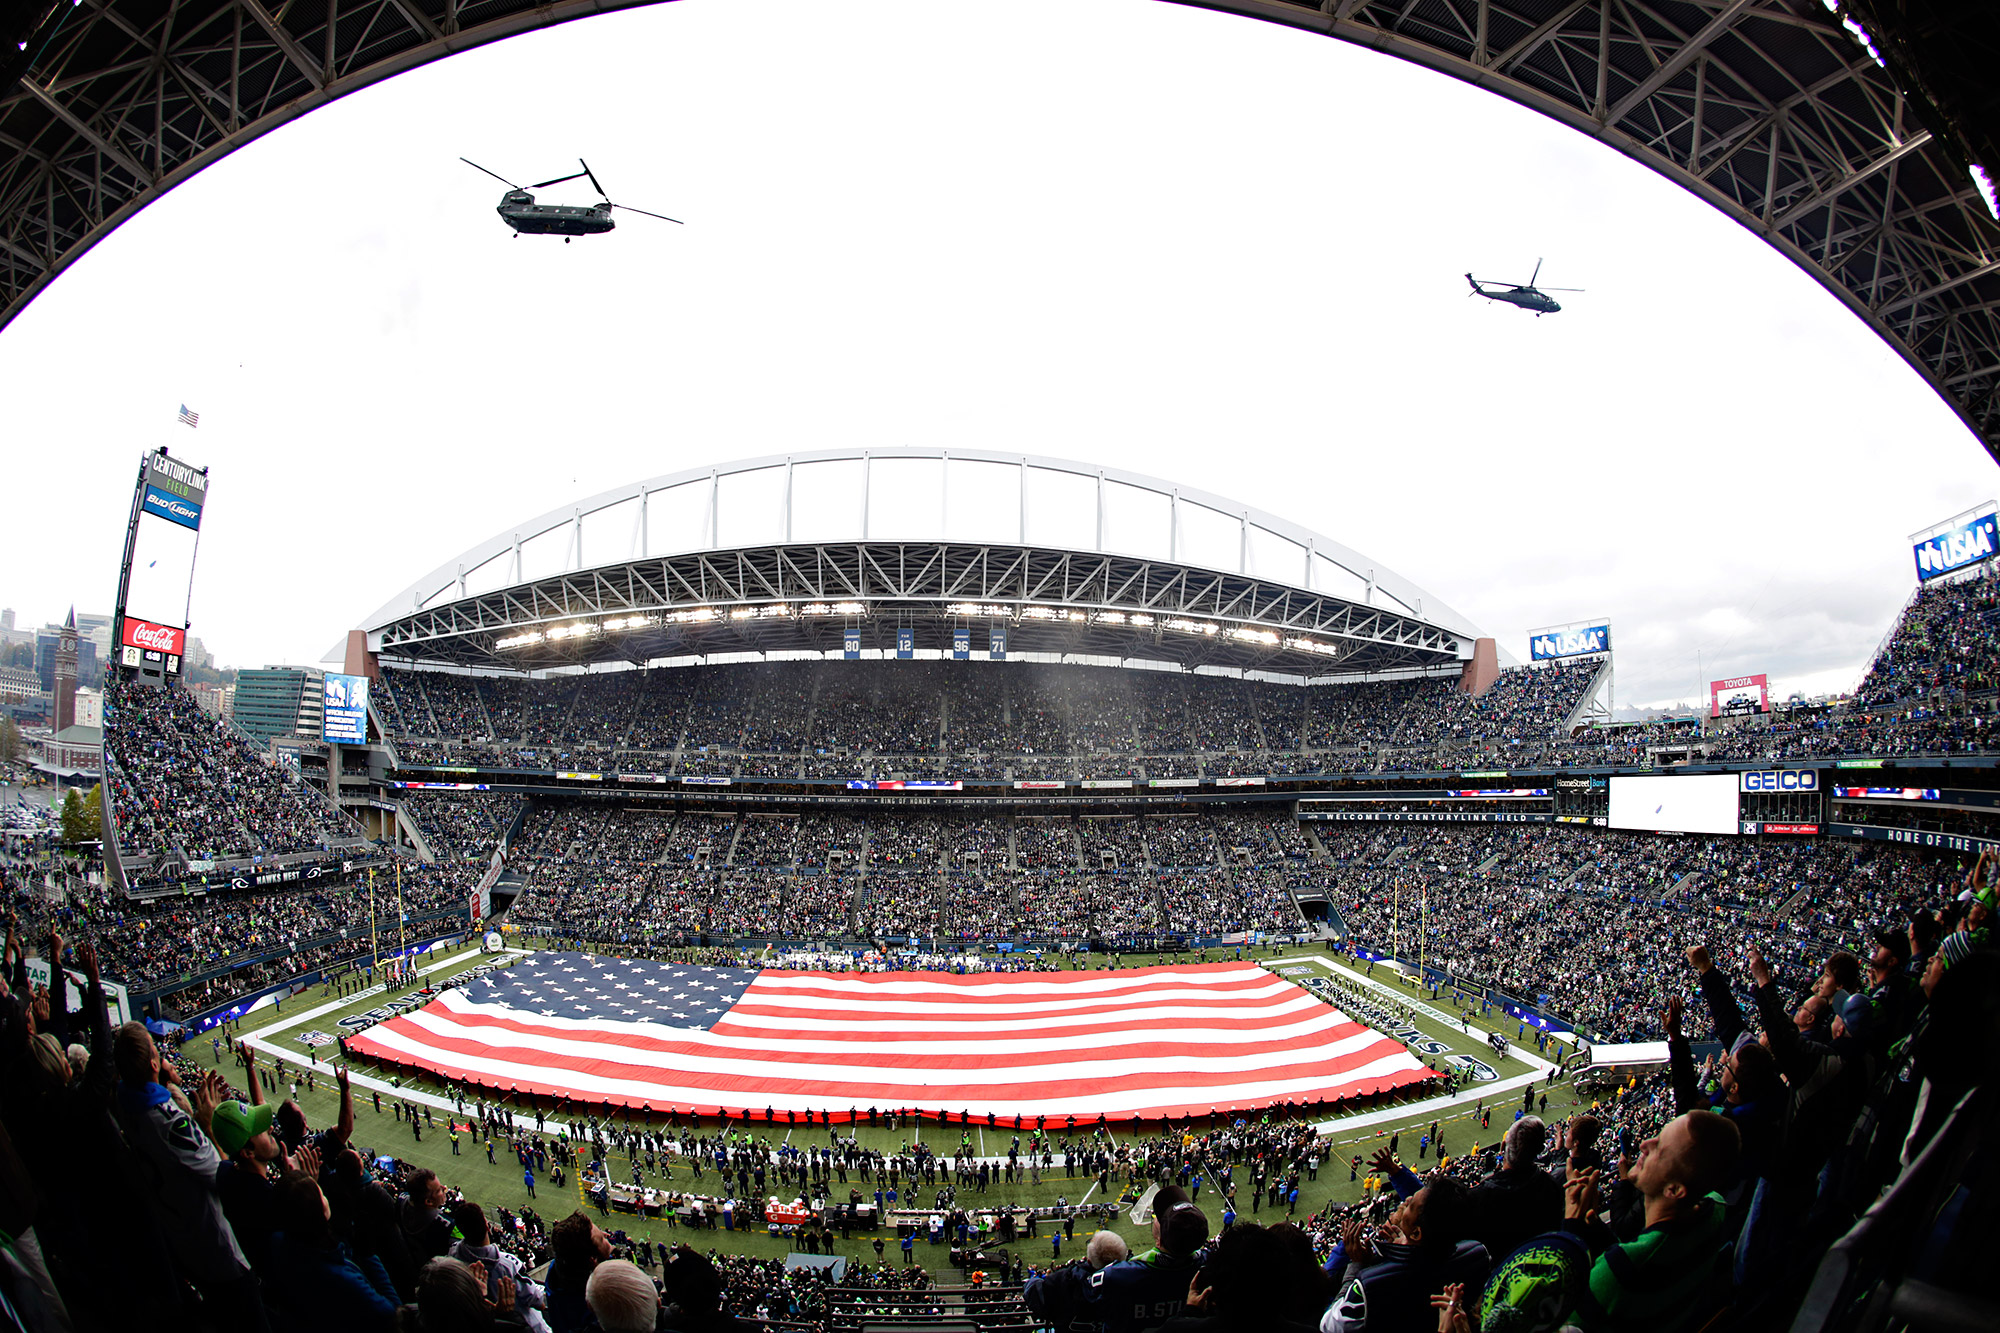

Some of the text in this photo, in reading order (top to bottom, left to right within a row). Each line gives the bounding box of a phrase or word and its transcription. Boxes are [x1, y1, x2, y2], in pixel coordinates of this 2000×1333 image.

[153, 453, 207, 492] CENTURYLINK
[166, 479, 189, 497] FIELD
[146, 493, 198, 520] BUD LIGHT
[1940, 525, 1993, 568] USAA
[845, 640, 859, 652] 80
[899, 639, 911, 651] 12
[954, 640, 969, 652] 96
[992, 641, 1004, 652] 71
[1556, 631, 1601, 655] USAA
[1724, 677, 1753, 689] TOYOTA
[1557, 778, 1606, 787] HomeStreet Bank
[1745, 770, 1816, 790] GEICO
[1888, 829, 1920, 844] HOME
[1926, 834, 1941, 846] OF
[1948, 837, 1970, 851] THE
[256, 871, 300, 885] HAWKS NEST
[1134, 1303, 1150, 1319] B.
